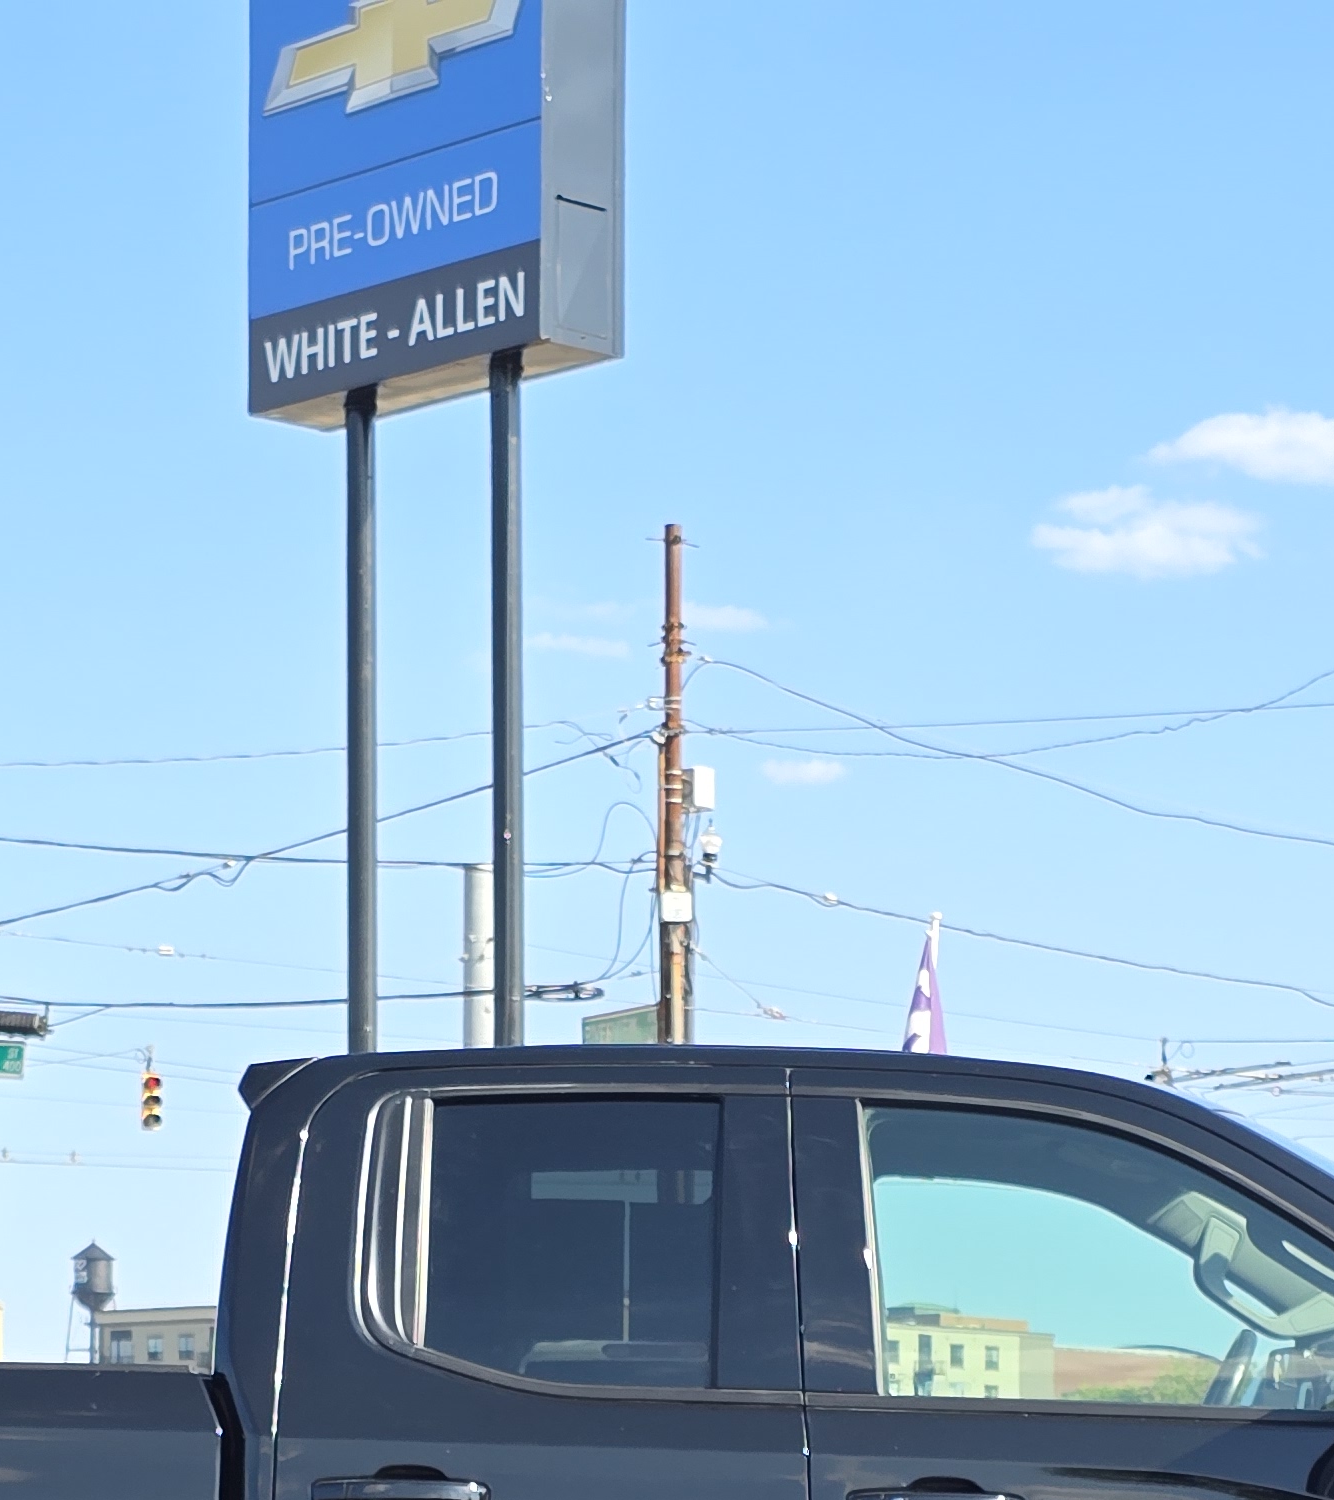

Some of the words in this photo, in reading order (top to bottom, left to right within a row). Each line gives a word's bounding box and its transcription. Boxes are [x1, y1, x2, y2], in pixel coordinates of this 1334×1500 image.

[288, 171, 498, 271] PRE-OWNED
[264, 312, 377, 383] WHITE
[407, 270, 526, 347] ALLEN
